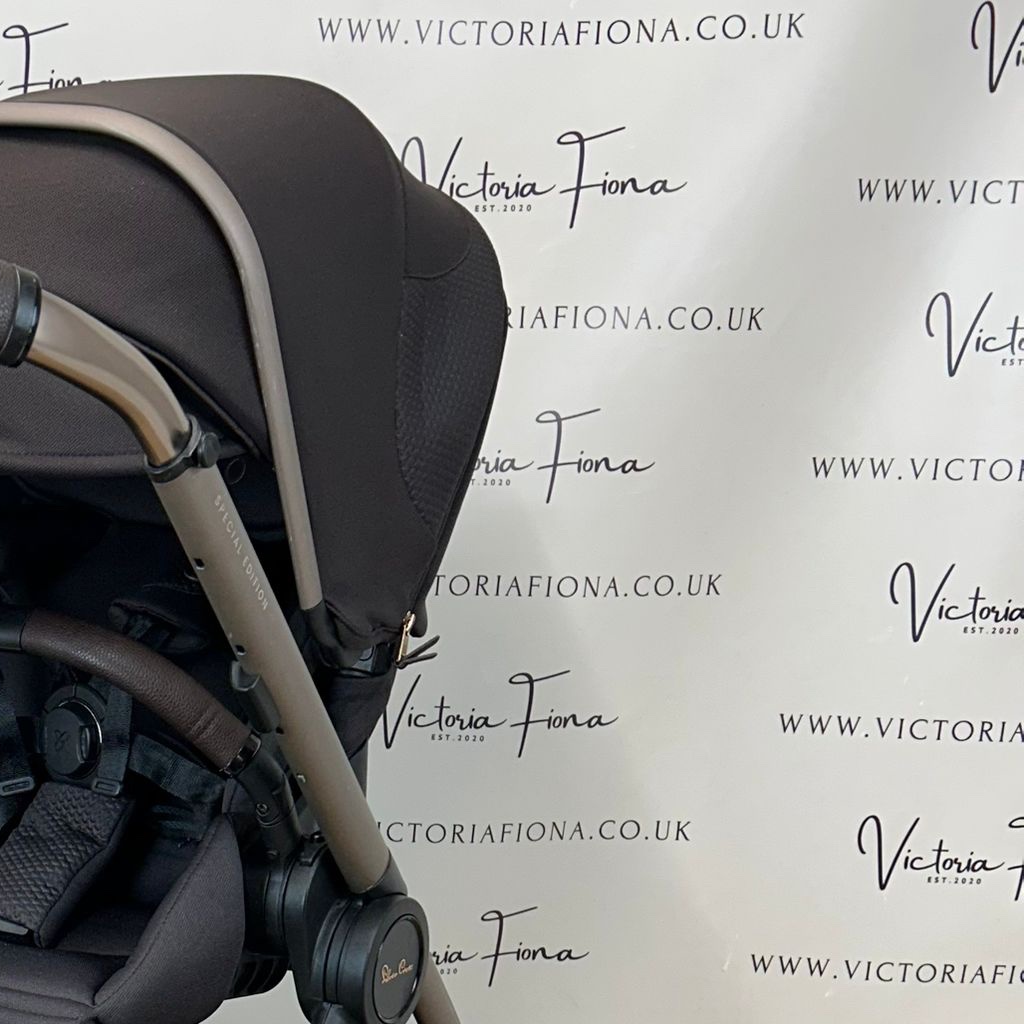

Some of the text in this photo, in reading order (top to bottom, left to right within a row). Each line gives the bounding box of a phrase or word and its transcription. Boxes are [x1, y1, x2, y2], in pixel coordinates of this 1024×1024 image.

[318, 13, 805, 46] WWW.VICTORIAFIONA.CO.UK
[400, 126, 688, 229] Victoria Fiona
[474, 204, 532, 213] EST.2020
[536, 408, 655, 504] Fiona
[242, 556, 269, 610] EDITION
[434, 574, 722, 598] TORIAFIONA.CO.UK
[963, 626, 1019, 635] EST.2020
[509, 670, 619, 758] Fiona
[431, 733, 484, 742] EST.2020
[378, 820, 691, 844] CTORIAFIONA.CO.UK
[857, 815, 1005, 891] Victoria
[927, 876, 982, 885] EST.2020
[481, 906, 590, 987] Fiona
